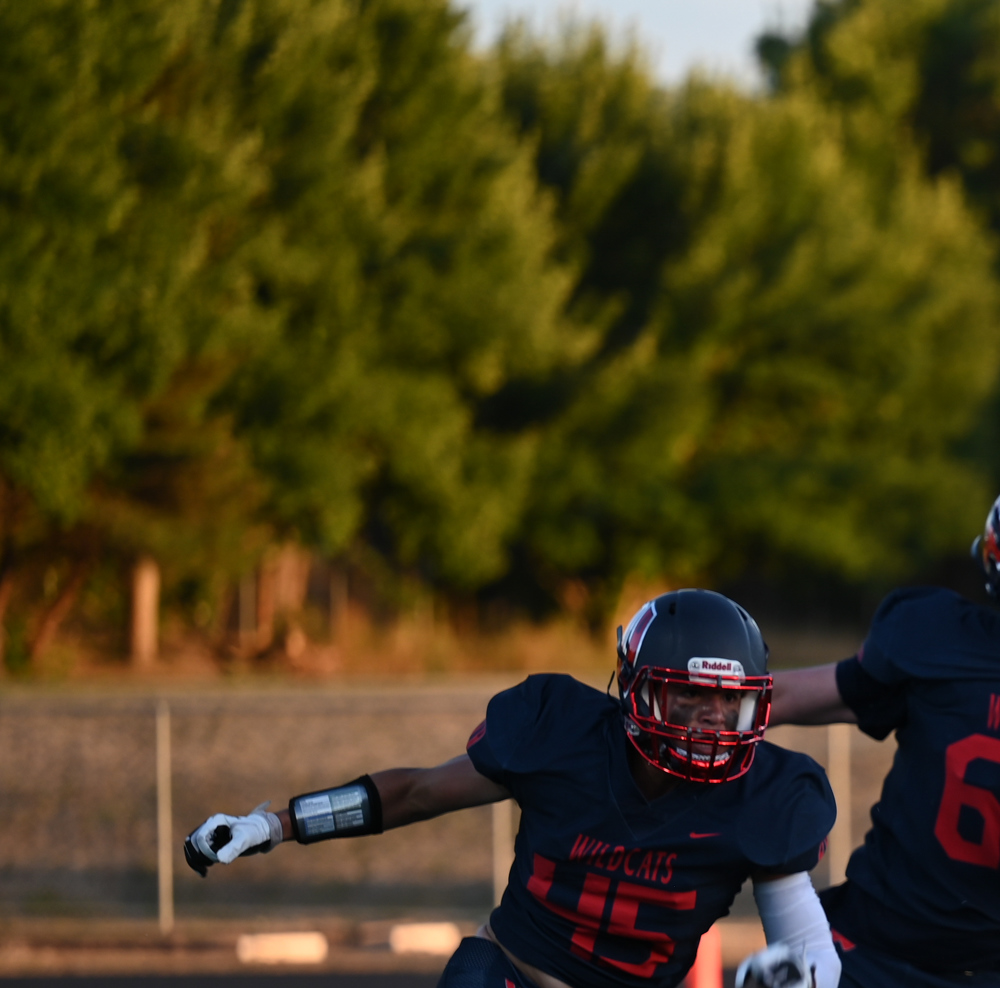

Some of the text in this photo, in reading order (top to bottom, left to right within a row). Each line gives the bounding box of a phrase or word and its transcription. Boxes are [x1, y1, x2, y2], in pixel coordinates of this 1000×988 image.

[701, 660, 732, 671] Riddell
[569, 833, 678, 885] WILDCATS
[526, 852, 698, 979] 45
